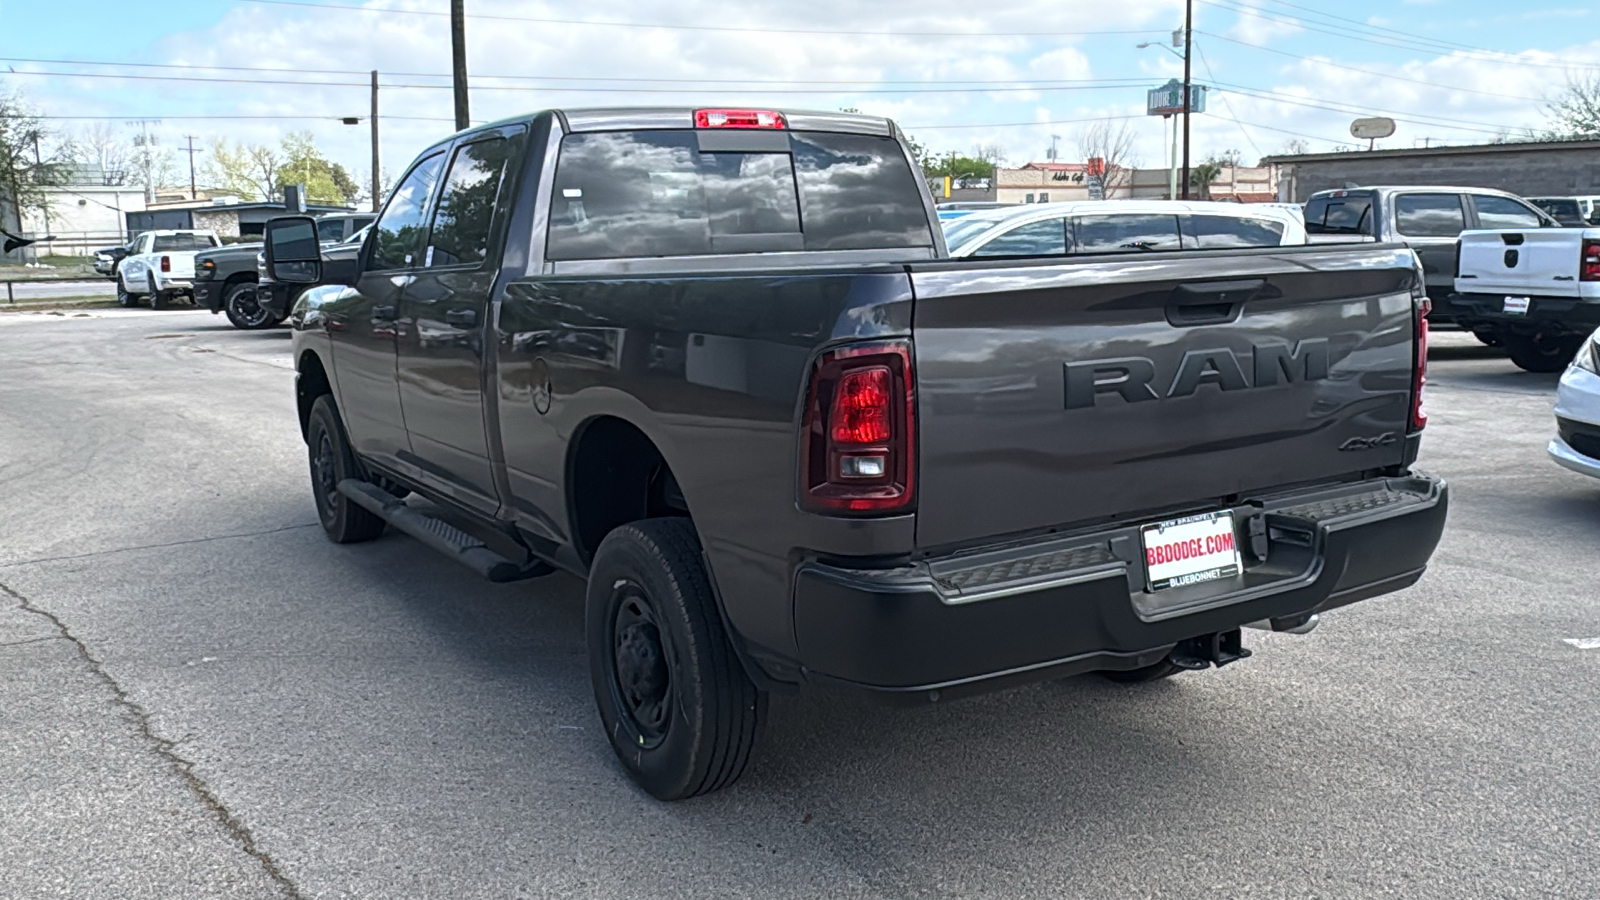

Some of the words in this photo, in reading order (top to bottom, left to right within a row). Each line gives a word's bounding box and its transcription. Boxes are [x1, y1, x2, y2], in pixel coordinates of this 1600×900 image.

[1150, 91, 1171, 108] ADOBE
[1063, 338, 1330, 410] RAM
[1338, 431, 1396, 451] 4x4
[1160, 520, 1176, 528] NEW
[1146, 532, 1234, 566] BBDODGE.COM
[1169, 568, 1221, 587] BLUEBONNET
